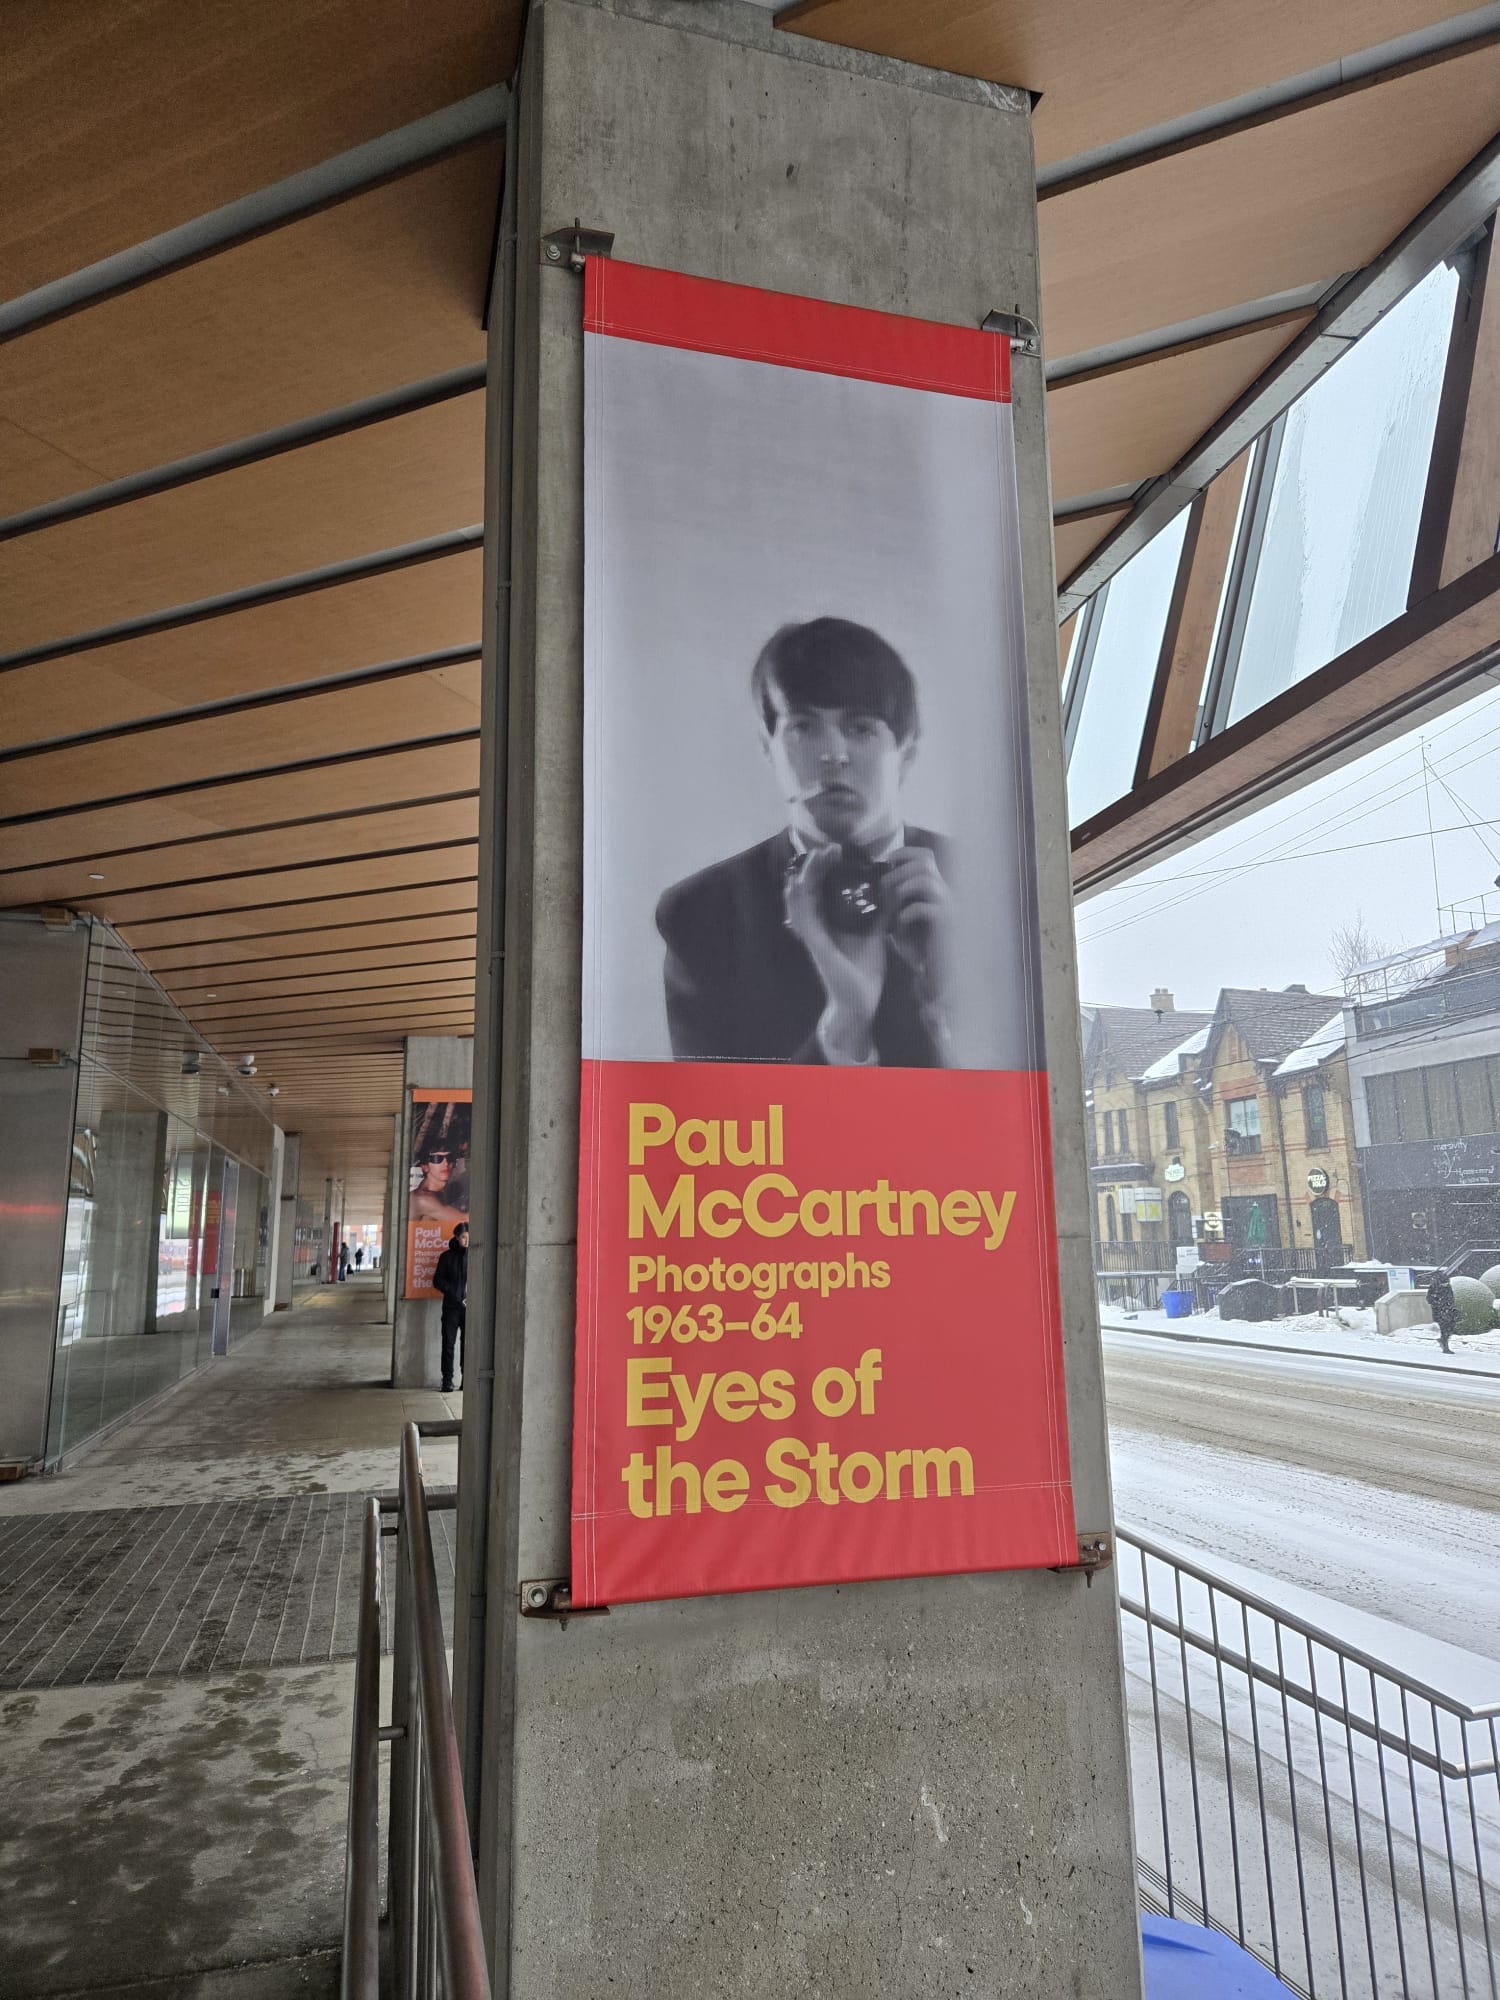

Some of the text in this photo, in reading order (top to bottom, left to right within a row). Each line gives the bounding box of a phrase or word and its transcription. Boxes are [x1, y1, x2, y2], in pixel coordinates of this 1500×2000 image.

[628, 1102, 784, 1167] Paul
[415, 1227, 441, 1237] Paul
[628, 1172, 1019, 1251] McCartney
[628, 1251, 891, 1300] Photographs
[626, 1347, 883, 1442] Eyes of
[621, 1437, 976, 1519] the Storm
